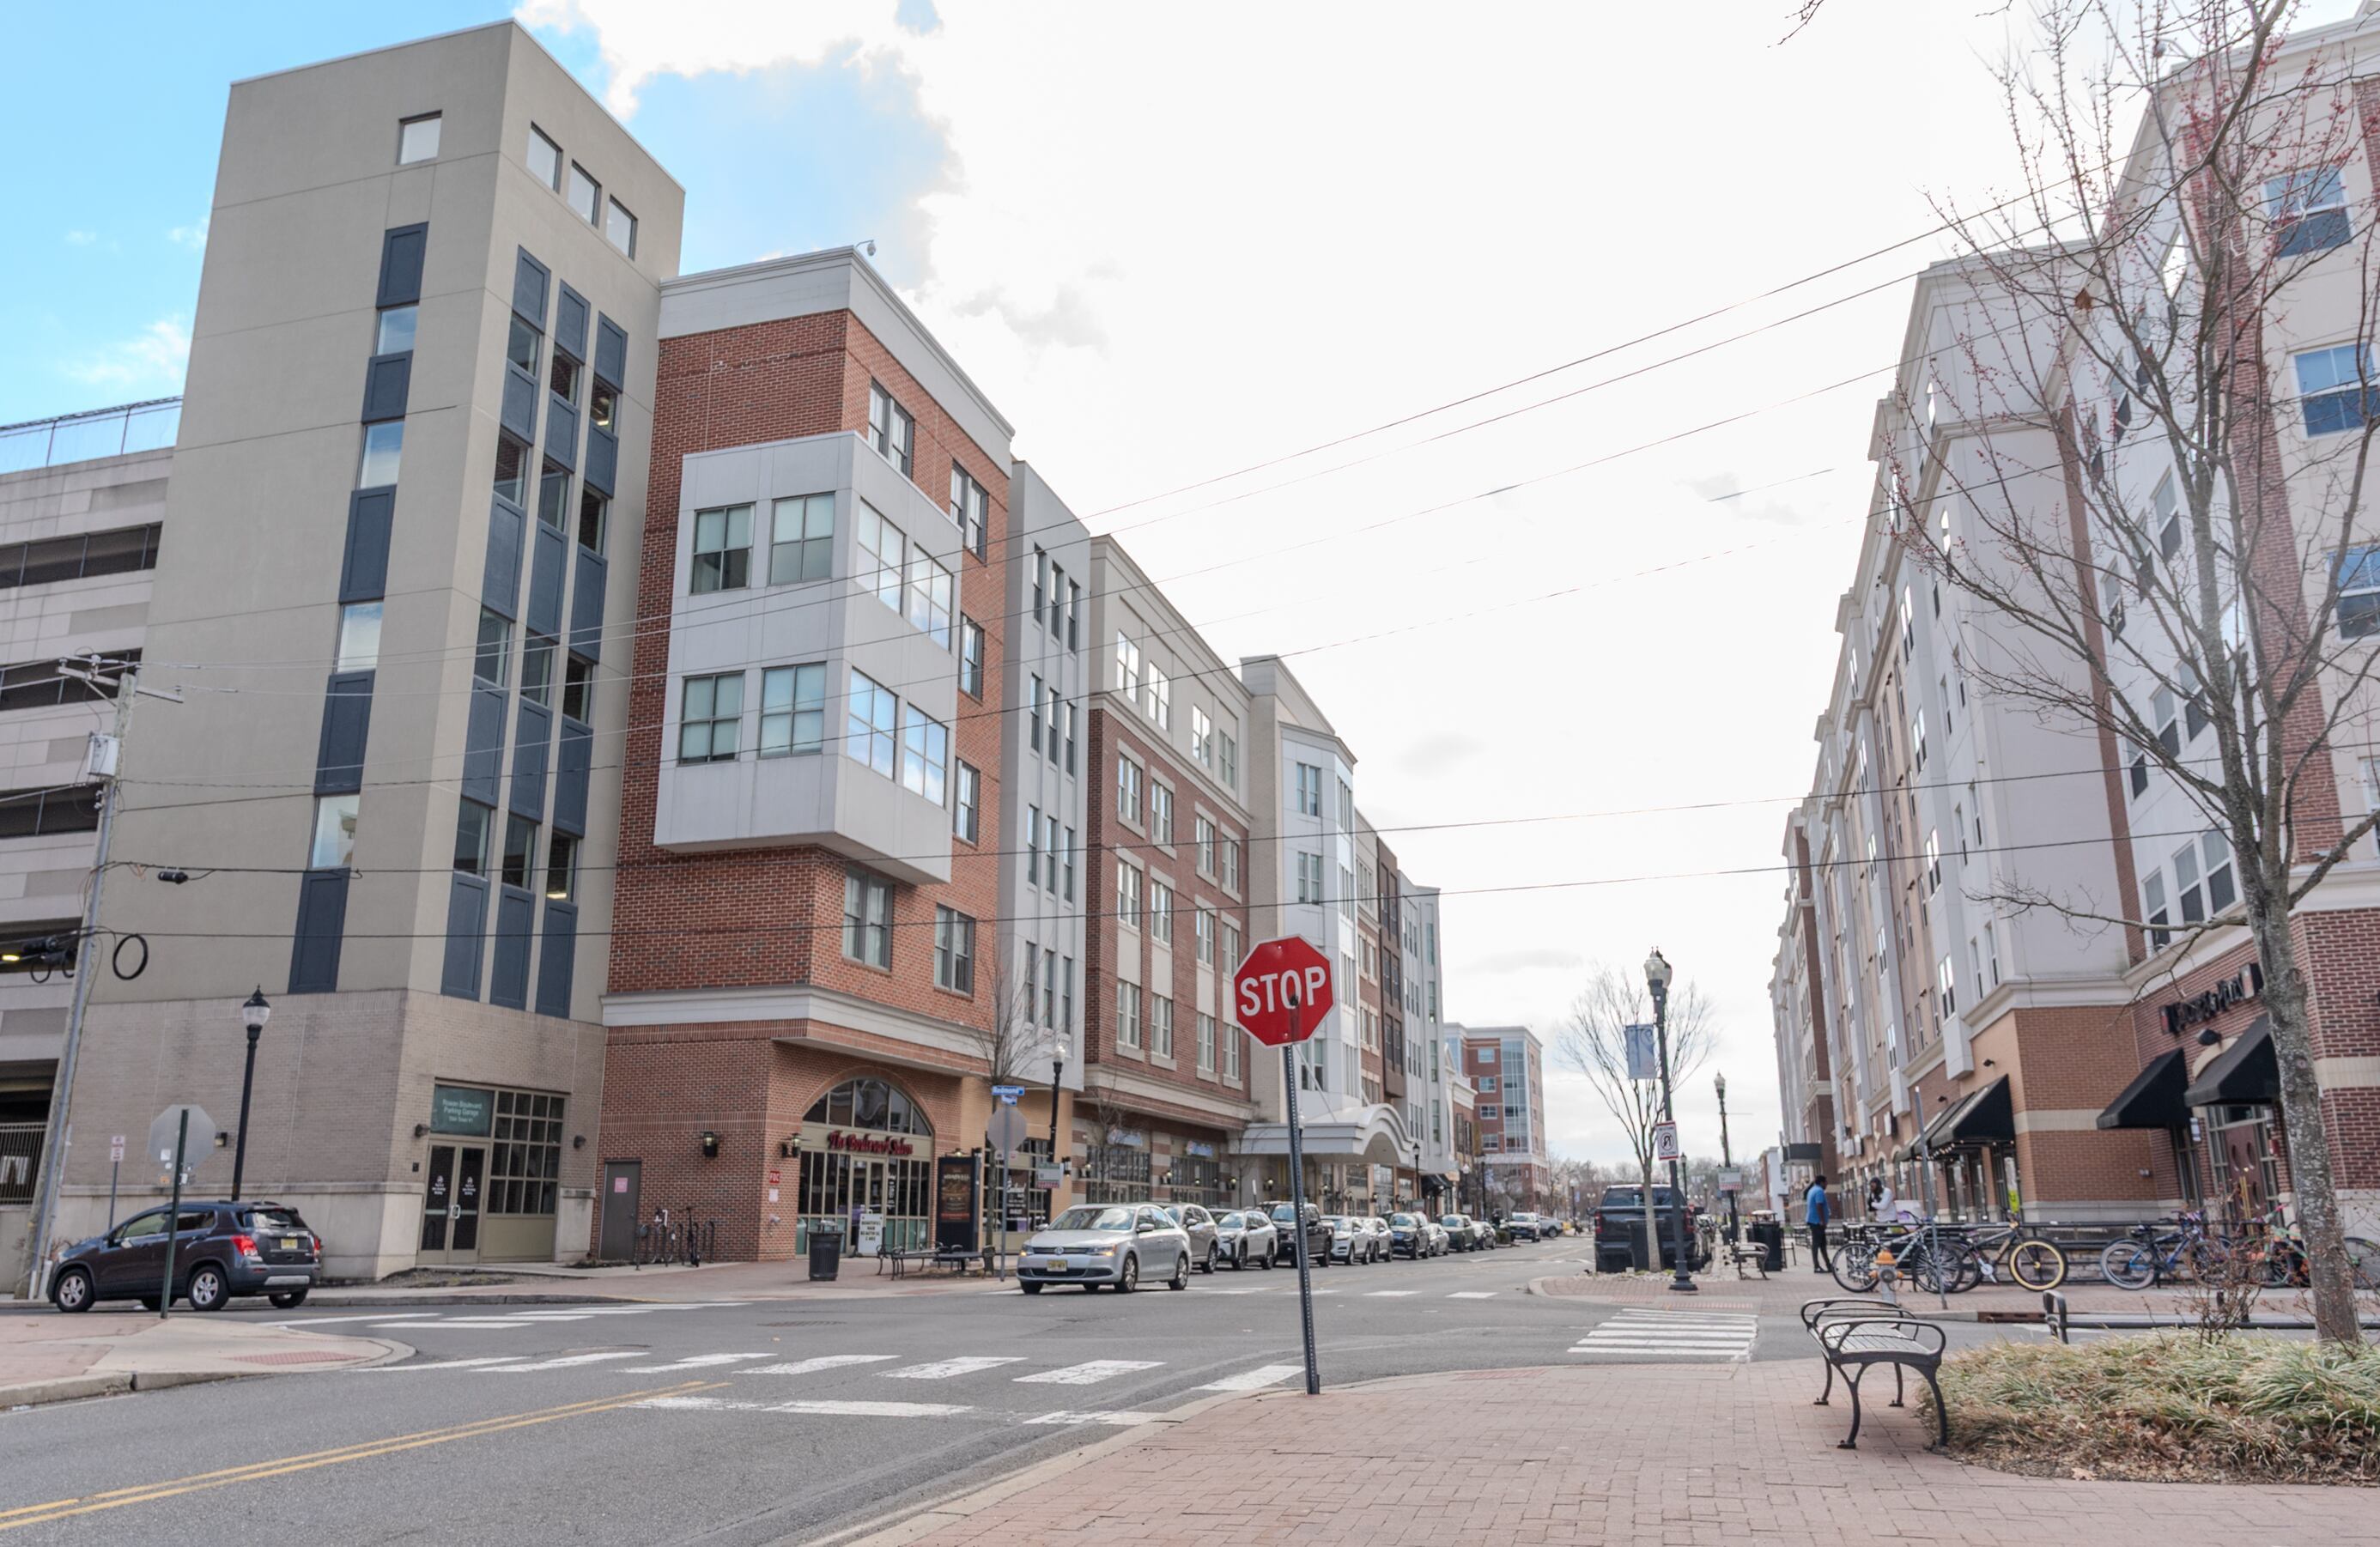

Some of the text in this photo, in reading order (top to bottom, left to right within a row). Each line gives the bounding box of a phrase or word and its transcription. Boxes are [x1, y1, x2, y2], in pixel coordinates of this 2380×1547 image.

[1240, 966, 1326, 1016] STOP
[443, 1106, 479, 1118] Parking Garage
[459, 1101, 483, 1109] Boulevard
[828, 1130, 845, 1150] The
[846, 1133, 889, 1155] Boulevard
